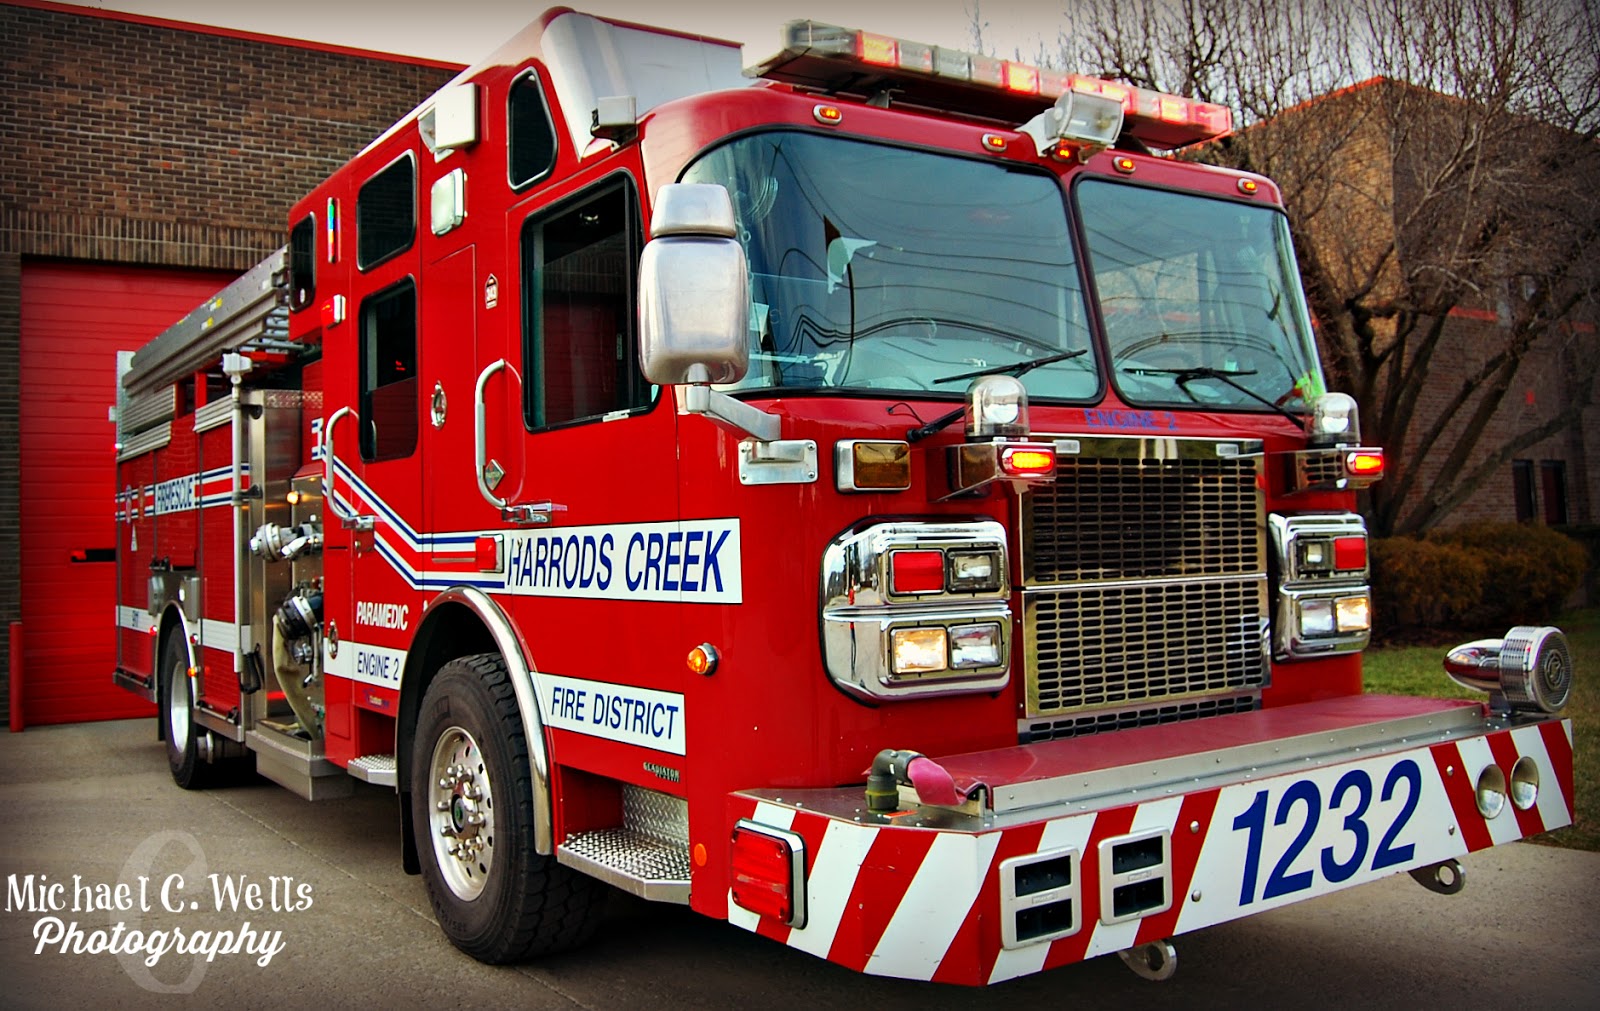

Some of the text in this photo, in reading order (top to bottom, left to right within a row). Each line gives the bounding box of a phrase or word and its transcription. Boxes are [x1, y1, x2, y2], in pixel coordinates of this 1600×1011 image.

[1083, 408, 1179, 431] ENGINE 2
[507, 529, 732, 592] HARRODS CREEK
[356, 600, 409, 631] PARAMEDIC
[357, 651, 400, 680] ENGINE 2
[551, 686, 679, 740] FIRE DISTRICT
[1231, 758, 1423, 906] 1232
